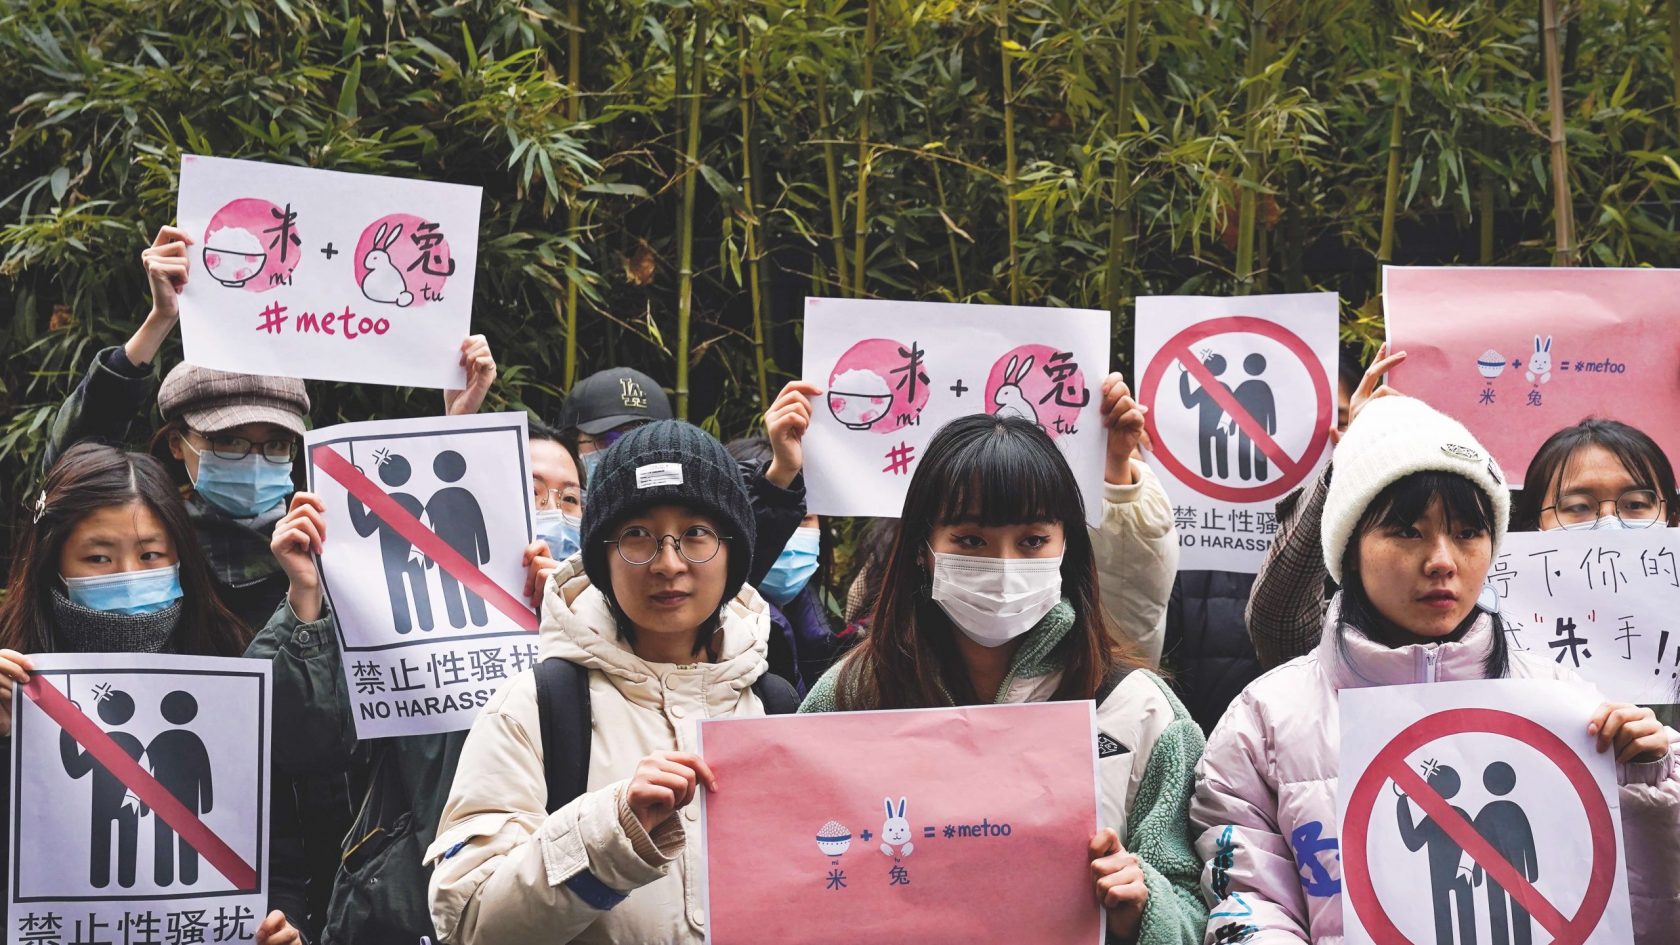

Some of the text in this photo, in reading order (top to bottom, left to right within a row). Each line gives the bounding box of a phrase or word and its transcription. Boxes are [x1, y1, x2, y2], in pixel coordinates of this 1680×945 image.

[263, 203, 302, 264] 米
[406, 221, 455, 277] 兔
[269, 268, 293, 286] mi
[420, 282, 444, 302] tu
[256, 301, 390, 339] #metoo
[890, 341, 930, 403] 米
[1039, 352, 1090, 407] 兔
[1479, 388, 1496, 405] 米
[1526, 389, 1542, 406] 兔
[896, 408, 921, 426] mi
[1052, 415, 1079, 435] tu
[360, 688, 497, 720] NO HARASS
[826, 868, 847, 890] 米
[888, 865, 910, 886] 兔
[19, 905, 255, 945] 禁止性骚扰
